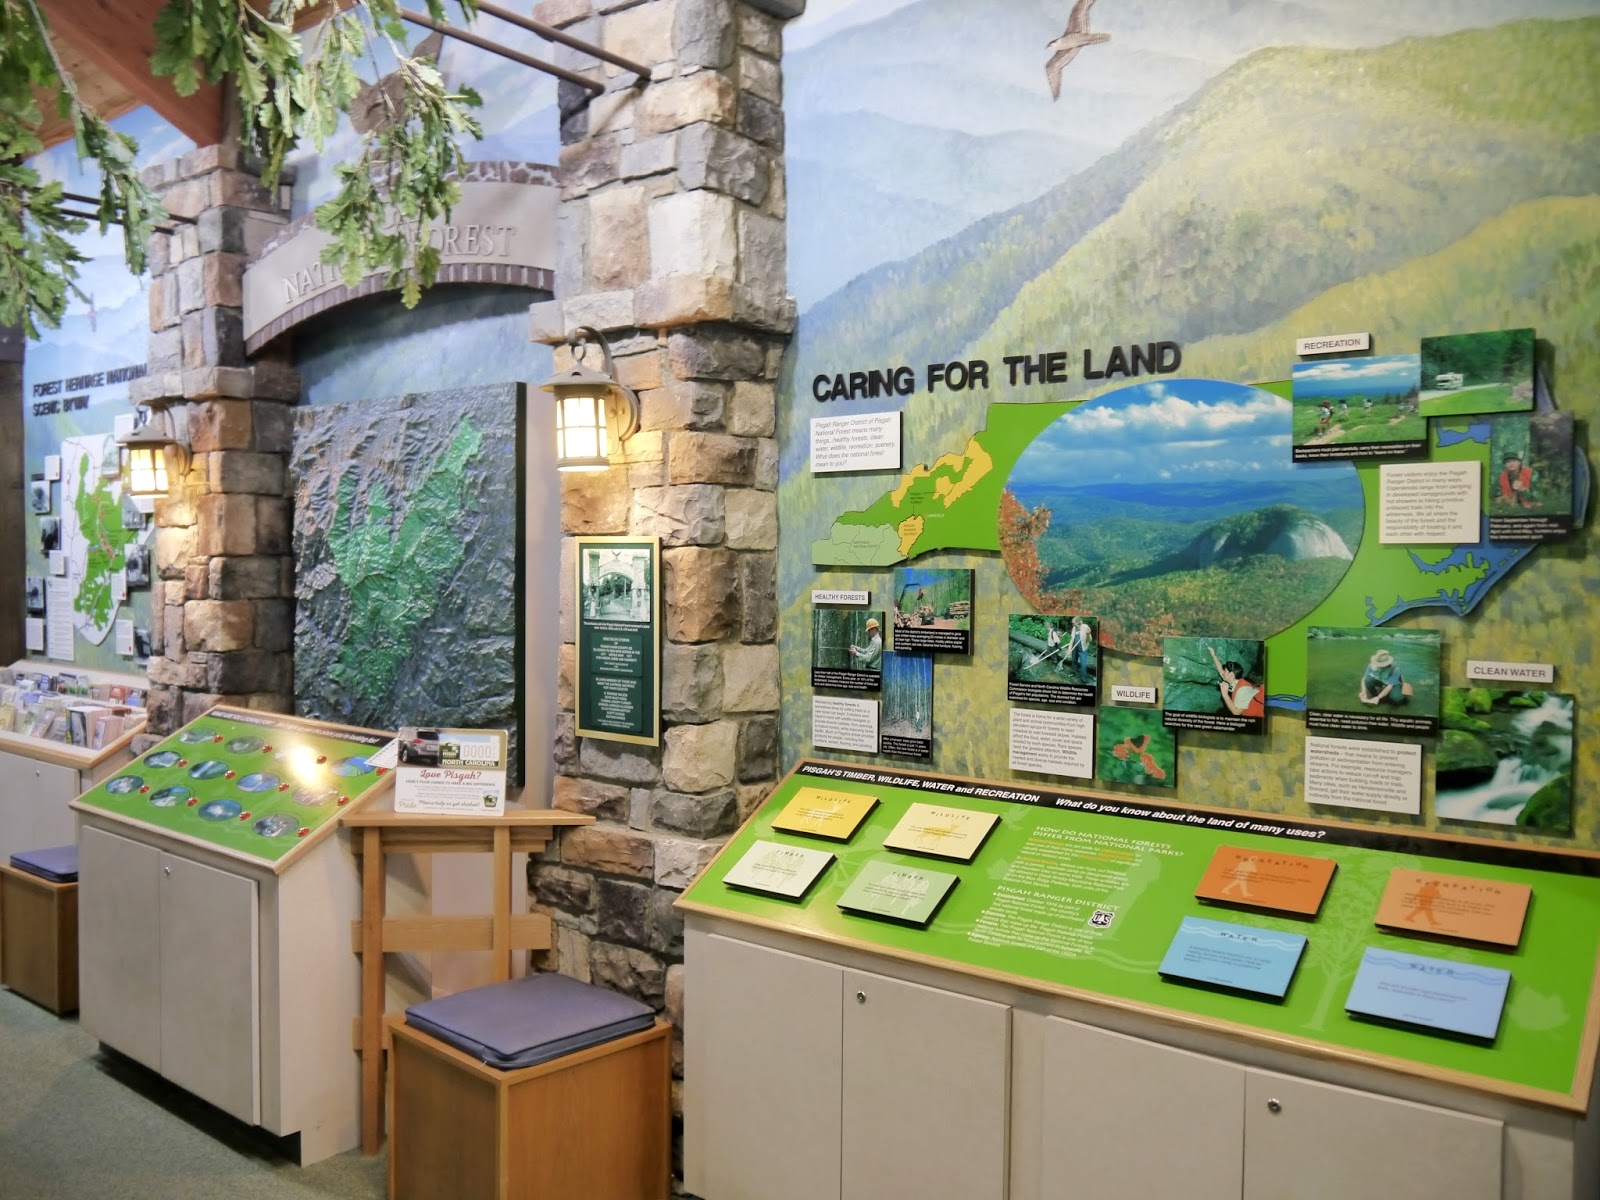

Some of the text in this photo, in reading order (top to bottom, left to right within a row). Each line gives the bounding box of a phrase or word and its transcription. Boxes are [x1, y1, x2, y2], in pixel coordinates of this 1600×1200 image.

[428, 223, 514, 257] OREST
[1304, 338, 1361, 351] RECREATION
[812, 341, 1182, 403] CARING FOR THE LAND
[33, 380, 63, 397] FOREST
[1474, 666, 1546, 678] CLEAN WATER
[1116, 690, 1150, 699] WILDLIFE
[420, 769, 482, 782] Love Pisgah?
[802, 765, 1040, 803] PISGAH'S TIMBER, WILDLIFE, WATER and RECREATION
[816, 795, 851, 804] WILDLIFE
[931, 811, 970, 820] WILDLIFE
[1055, 798, 1326, 839] What do you know about the land of many uses?
[1032, 831, 1184, 857] DIFFER FROM NATIONAL PARKS?
[1078, 831, 1129, 844] NATIONAL
[1132, 839, 1171, 850] FORESTS
[776, 849, 804, 858] TIMBER
[1235, 855, 1309, 869] RECREATION
[892, 871, 924, 881] TIMBER
[1416, 879, 1500, 895] RECREATION
[997, 885, 1120, 911] PISGAH RANGER DISTRICT
[1220, 932, 1258, 942] WATER
[1410, 962, 1454, 976] WATER
